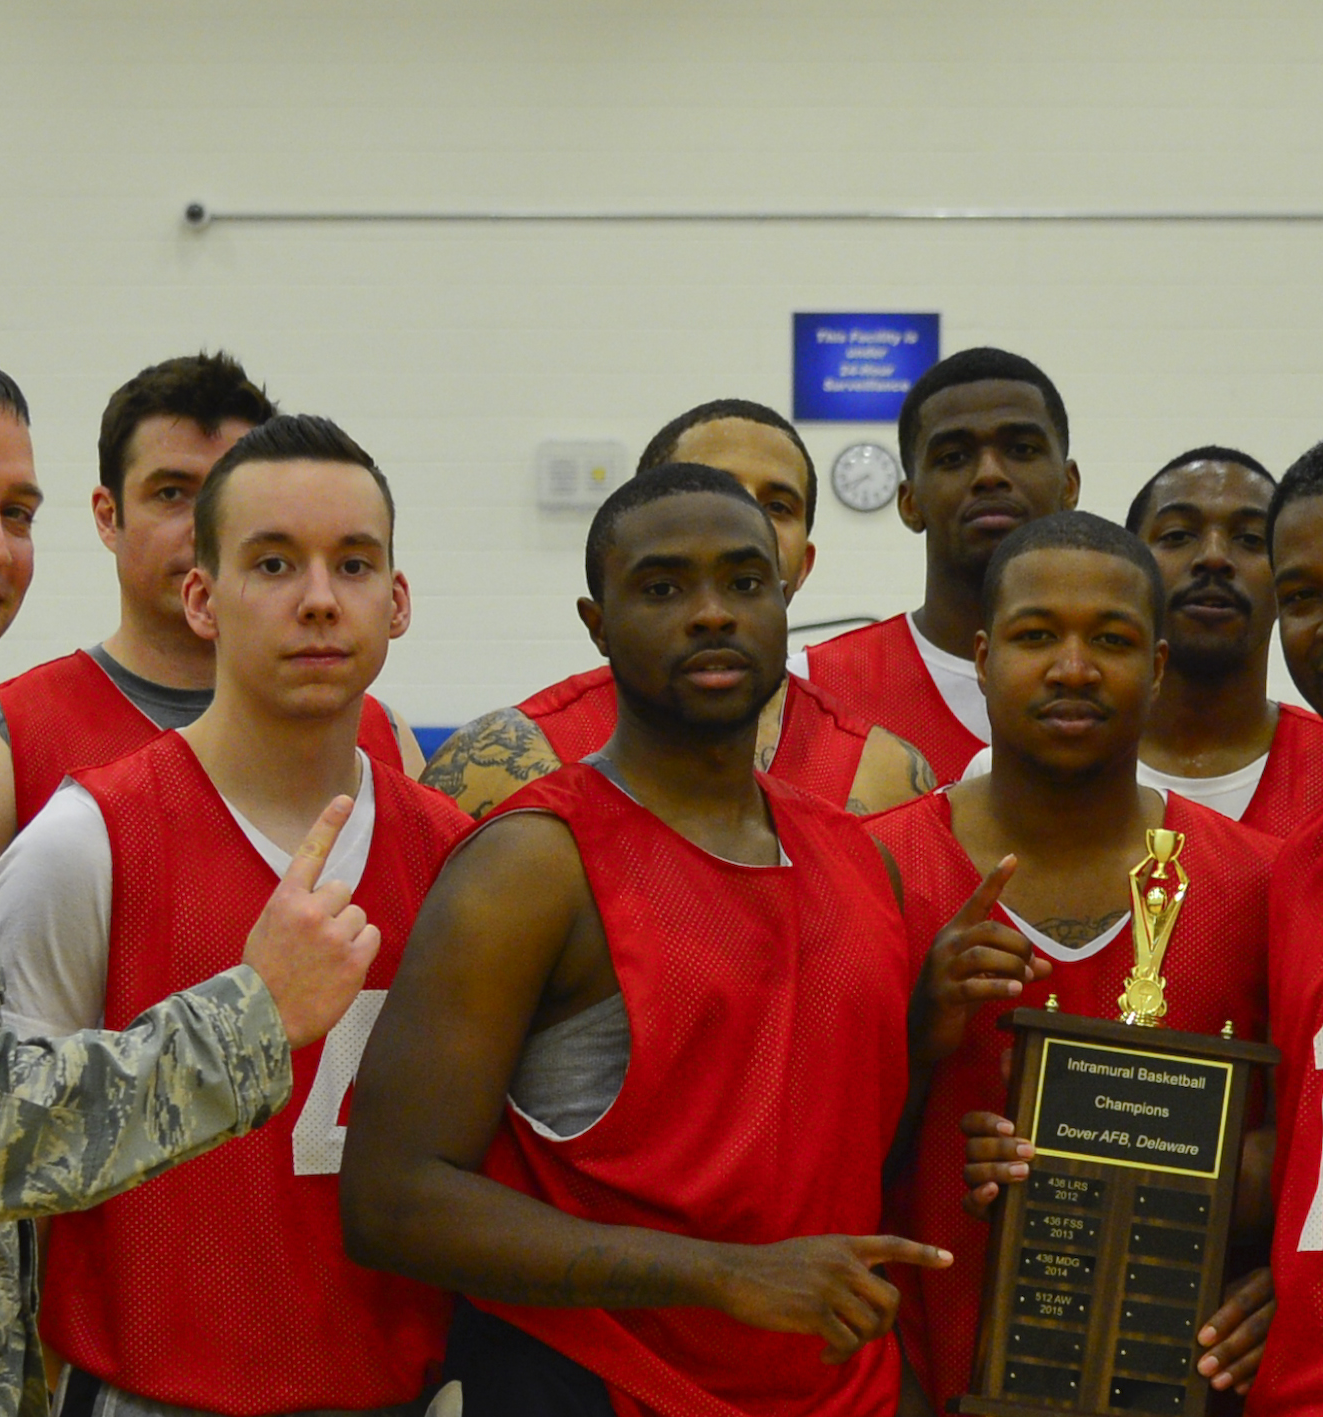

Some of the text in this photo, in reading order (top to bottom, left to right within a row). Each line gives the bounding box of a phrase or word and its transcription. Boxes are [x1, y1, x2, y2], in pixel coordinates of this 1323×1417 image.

[1066, 1057, 1206, 1090] Intramural Basketball
[1094, 1095, 1170, 1118] Champions
[1056, 1123, 1199, 1156] Dover AFB, Delaware
[1055, 1190, 1079, 1202] 2012
[1063, 1218, 1084, 1230] FSS
[1049, 1228, 1074, 1240] 2013
[1055, 1256, 1080, 1267] MDG
[1044, 1266, 1068, 1277] 2014
[1035, 1291, 1053, 1303] 512
[1039, 1304, 1064, 1316] 2015
